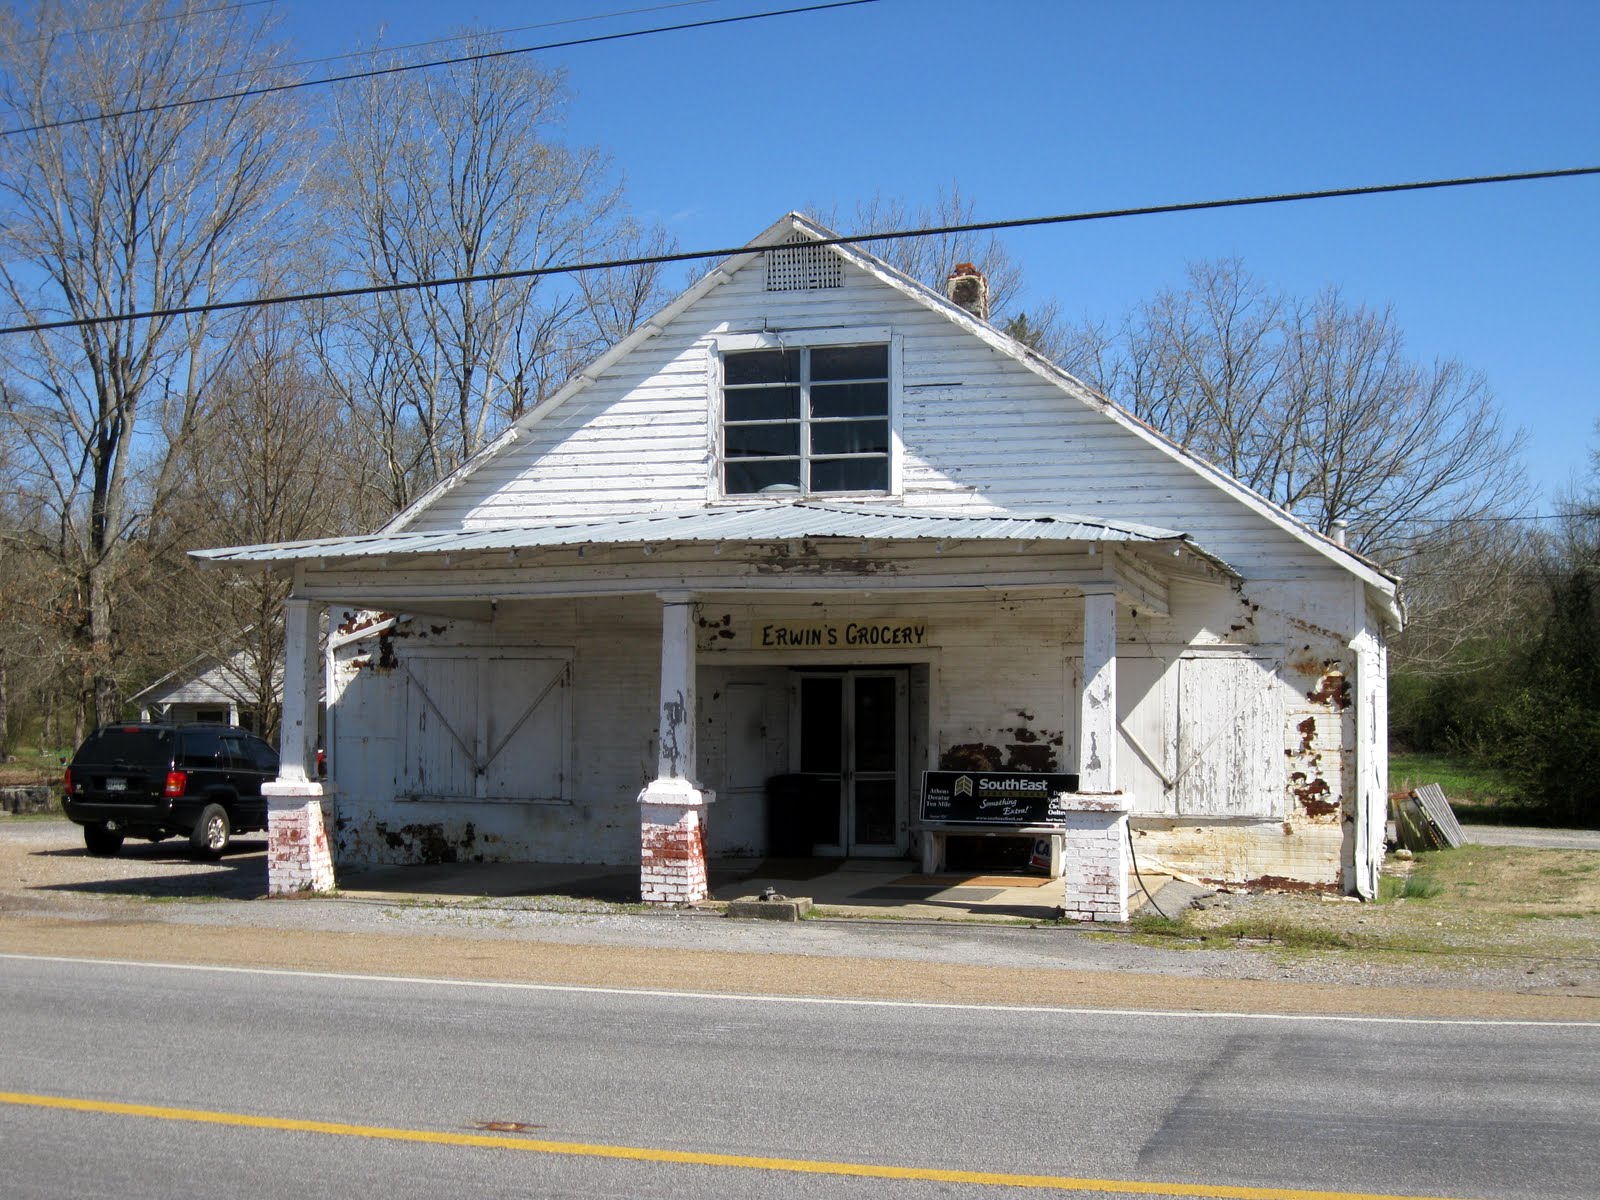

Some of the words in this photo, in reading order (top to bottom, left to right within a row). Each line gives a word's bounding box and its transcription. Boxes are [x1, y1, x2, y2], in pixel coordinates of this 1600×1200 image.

[762, 624, 838, 646] ERWIN'S
[845, 622, 926, 645] GROCERY
[978, 778, 1049, 791] SouthEast
[979, 798, 1018, 809] Something
[1003, 806, 1029, 816] Extra!
[1035, 839, 1049, 856] CA
